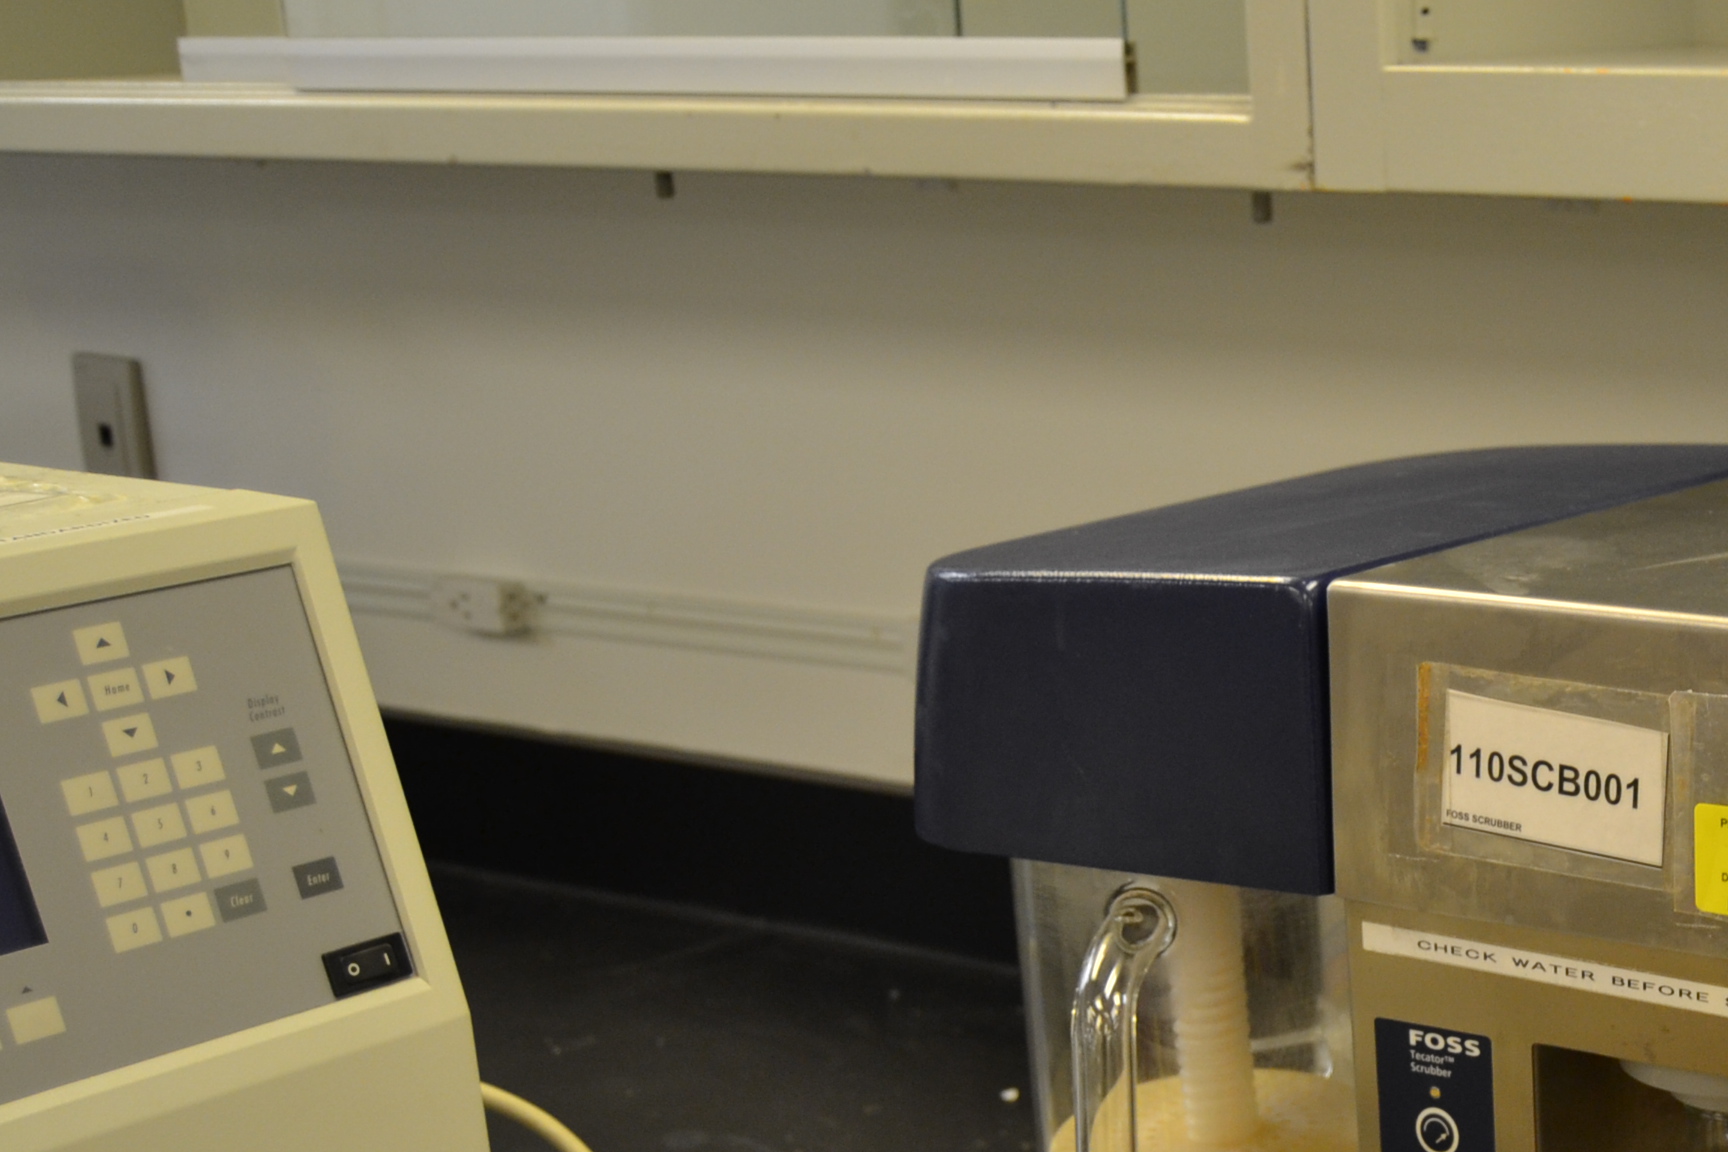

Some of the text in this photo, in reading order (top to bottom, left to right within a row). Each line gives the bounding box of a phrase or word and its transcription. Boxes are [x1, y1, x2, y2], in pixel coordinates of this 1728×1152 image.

[104, 683, 130, 696] Home
[247, 693, 280, 710] Display
[249, 705, 286, 722] Contrast
[1450, 744, 1640, 810] 110SCB001
[1446, 808, 1522, 833] FOSS SCRUBBER
[307, 871, 331, 887] Enter
[230, 893, 254, 908] Clear
[1417, 940, 1498, 964] CHECK
[1512, 957, 1596, 982] WATER
[1611, 976, 1710, 1003] BEFORE
[1408, 1028, 1482, 1058] FOSS
[1410, 1061, 1452, 1078] Scrubber
